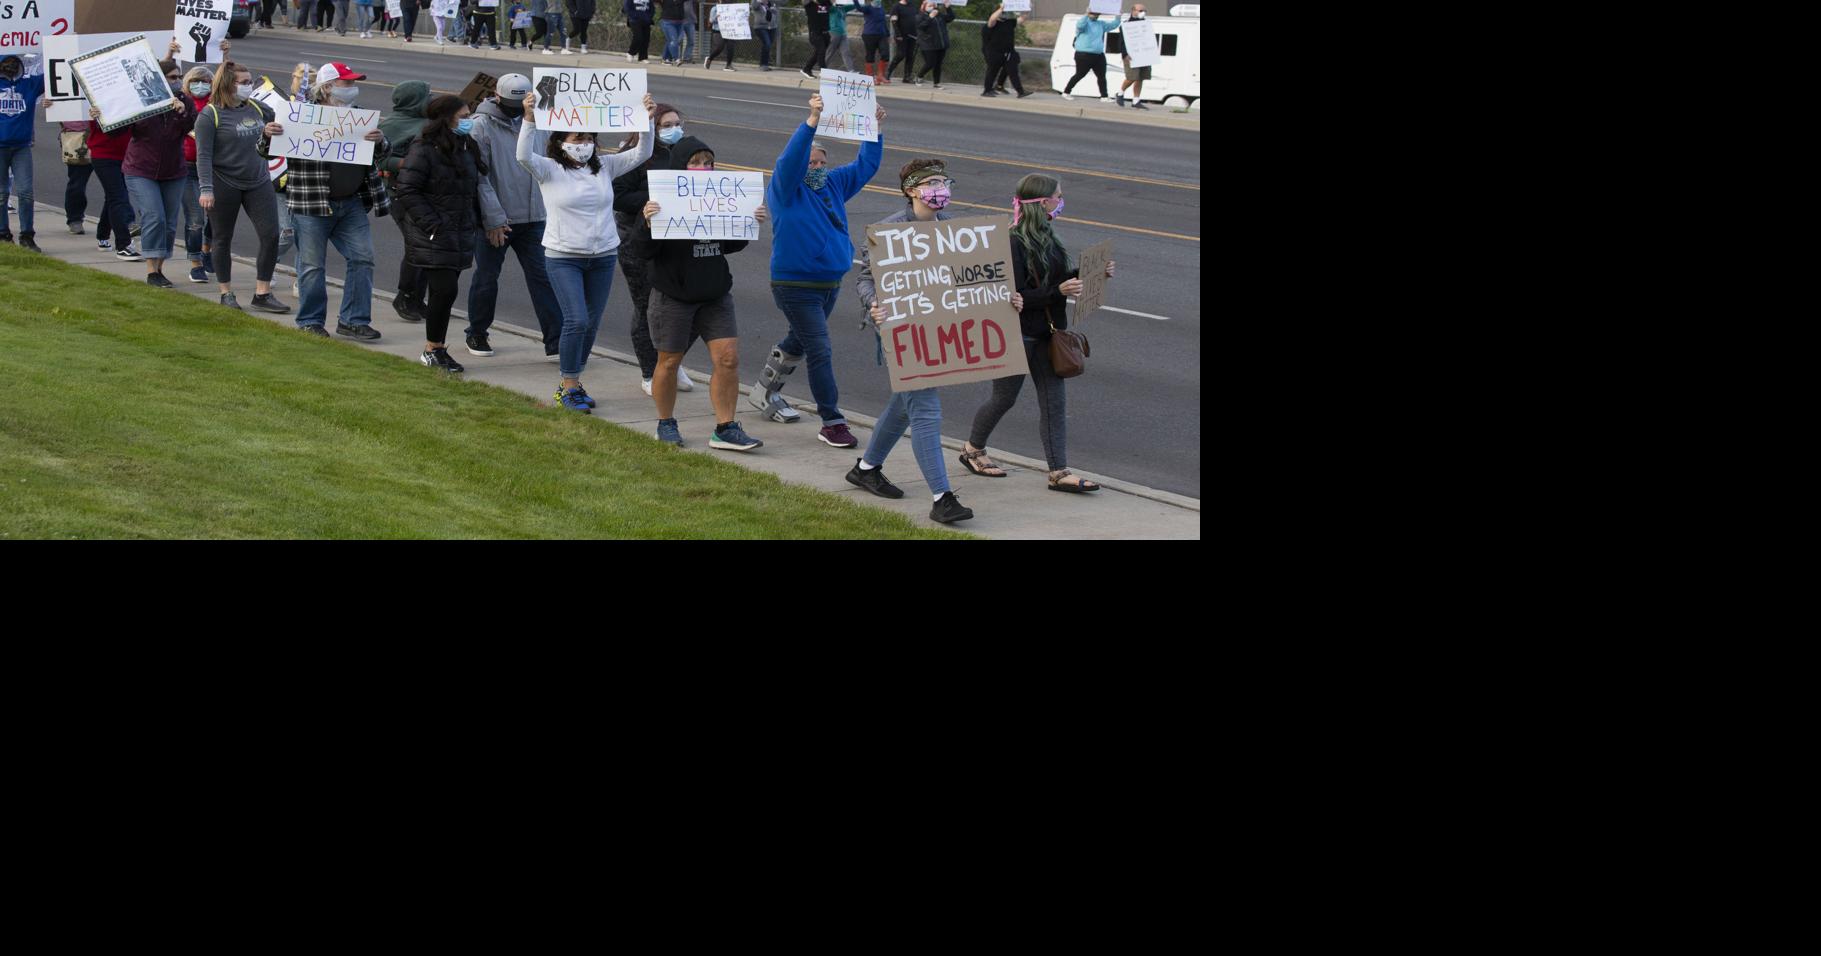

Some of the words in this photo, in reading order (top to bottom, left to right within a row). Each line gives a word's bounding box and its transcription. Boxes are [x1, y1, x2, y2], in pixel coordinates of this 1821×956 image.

[22, 0, 39, 19] A
[558, 72, 631, 93] BLACK
[837, 75, 872, 100] BLACK
[569, 91, 612, 106] LIVES
[288, 102, 375, 126] MATTER
[549, 106, 635, 128] MATTER
[825, 114, 872, 136] MATTER
[313, 123, 354, 142] LIVES
[287, 137, 357, 161] BLACK
[677, 175, 747, 198] BLACK
[689, 198, 738, 213] LIVES
[664, 215, 754, 238] MATTER
[874, 225, 930, 267] IT'S
[934, 225, 996, 255] NOT
[881, 264, 952, 296] GETTING
[951, 261, 1006, 281] WORSE
[881, 290, 935, 322] IT'S
[941, 284, 1011, 314] GETTING
[892, 318, 1007, 367] FILMED
